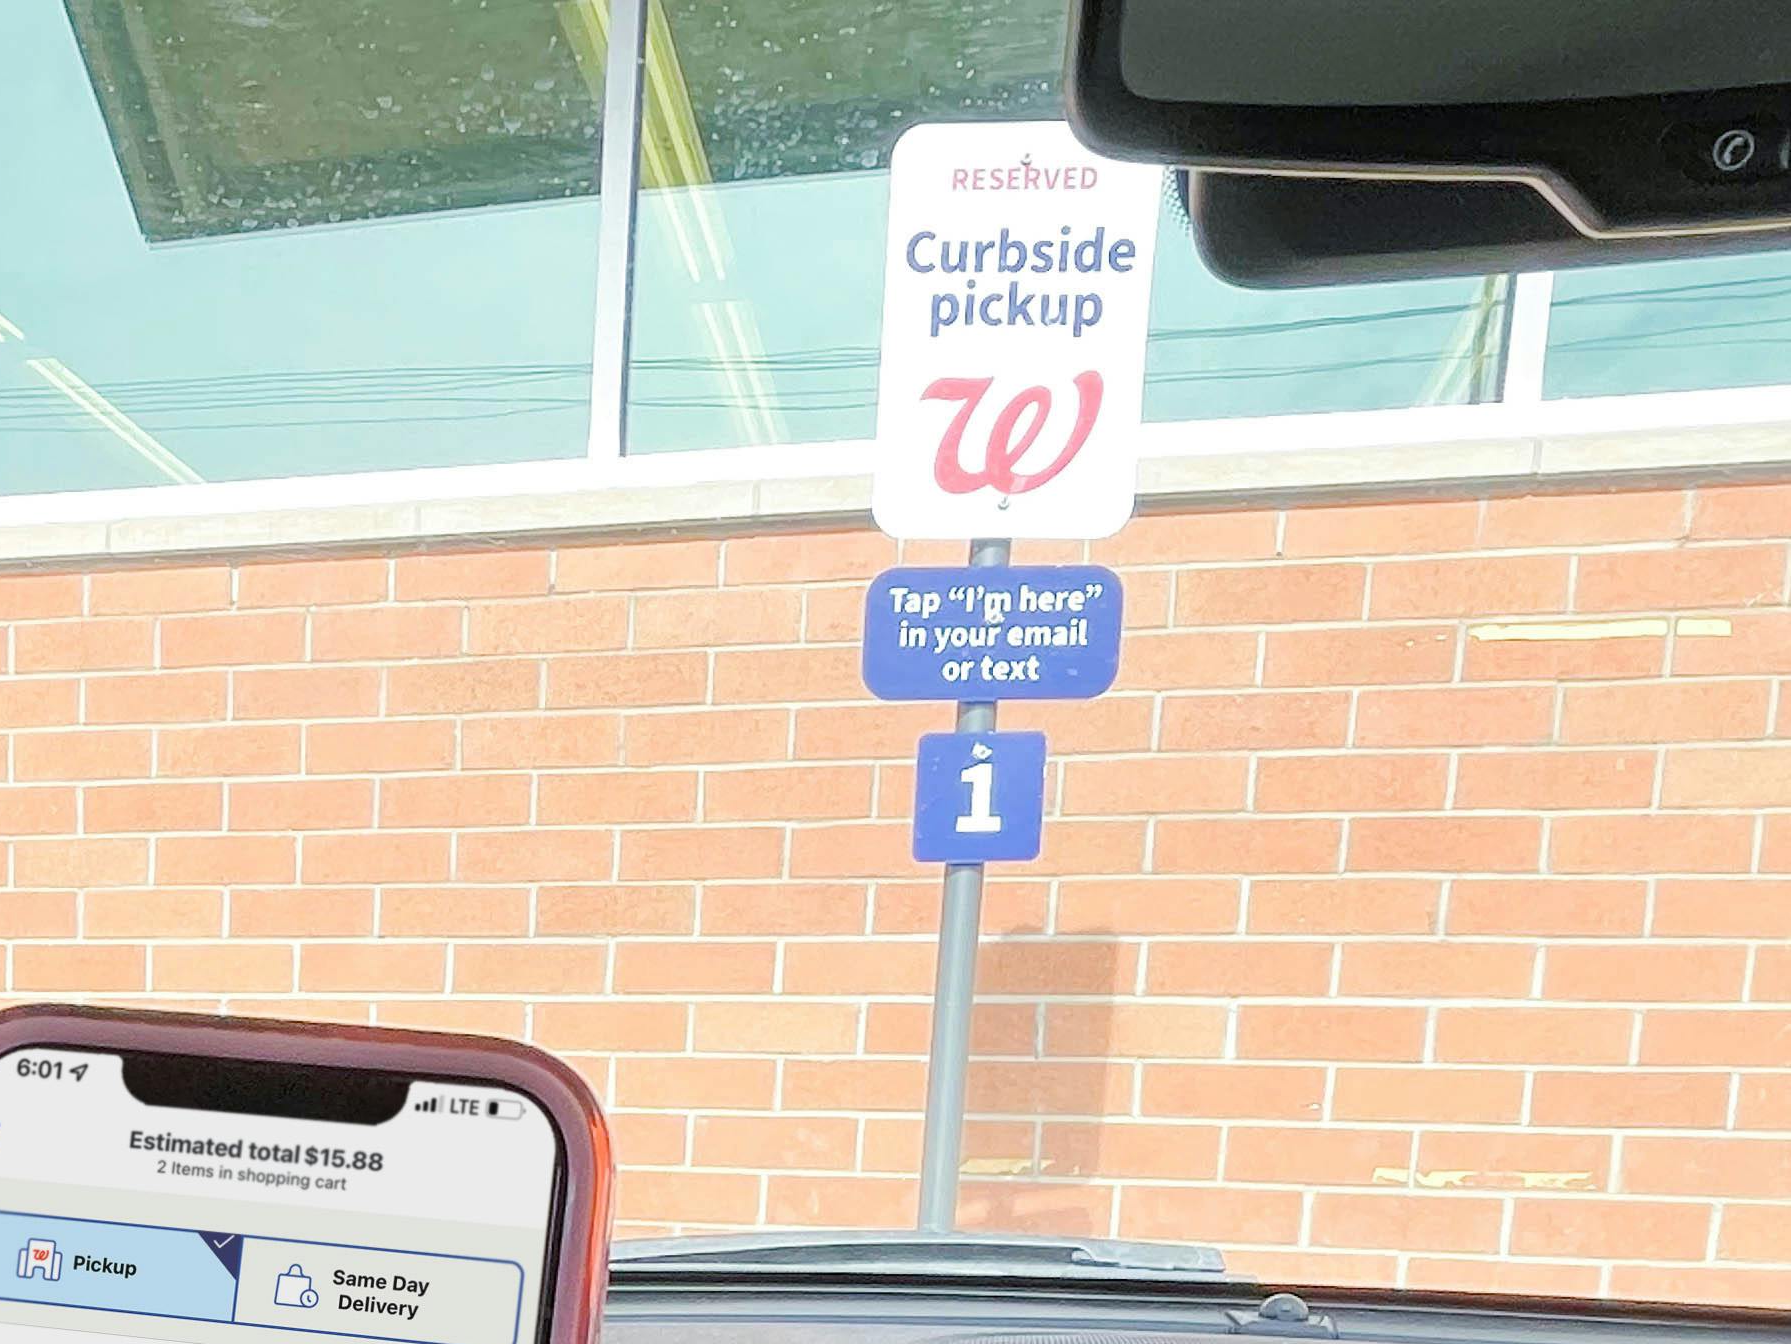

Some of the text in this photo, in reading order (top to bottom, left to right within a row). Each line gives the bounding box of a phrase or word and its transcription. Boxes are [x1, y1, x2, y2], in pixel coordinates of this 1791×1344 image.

[952, 167, 1099, 191] RESERVED
[906, 224, 1136, 274] Curbside
[930, 279, 1103, 338] pickup
[919, 370, 1104, 496] W
[890, 587, 940, 618] Tap
[899, 619, 1088, 653] in your email
[942, 656, 1040, 681] or text
[955, 762, 1001, 833] 1
[16, 1058, 480, 1116] 6:01 LTE
[129, 1130, 384, 1172] Estimated total $15.88
[156, 1159, 347, 1191] 2 Items in shopping cart
[73, 1255, 137, 1279] Pickup
[332, 1269, 430, 1297] Same Day
[338, 1294, 419, 1321] Delivery
